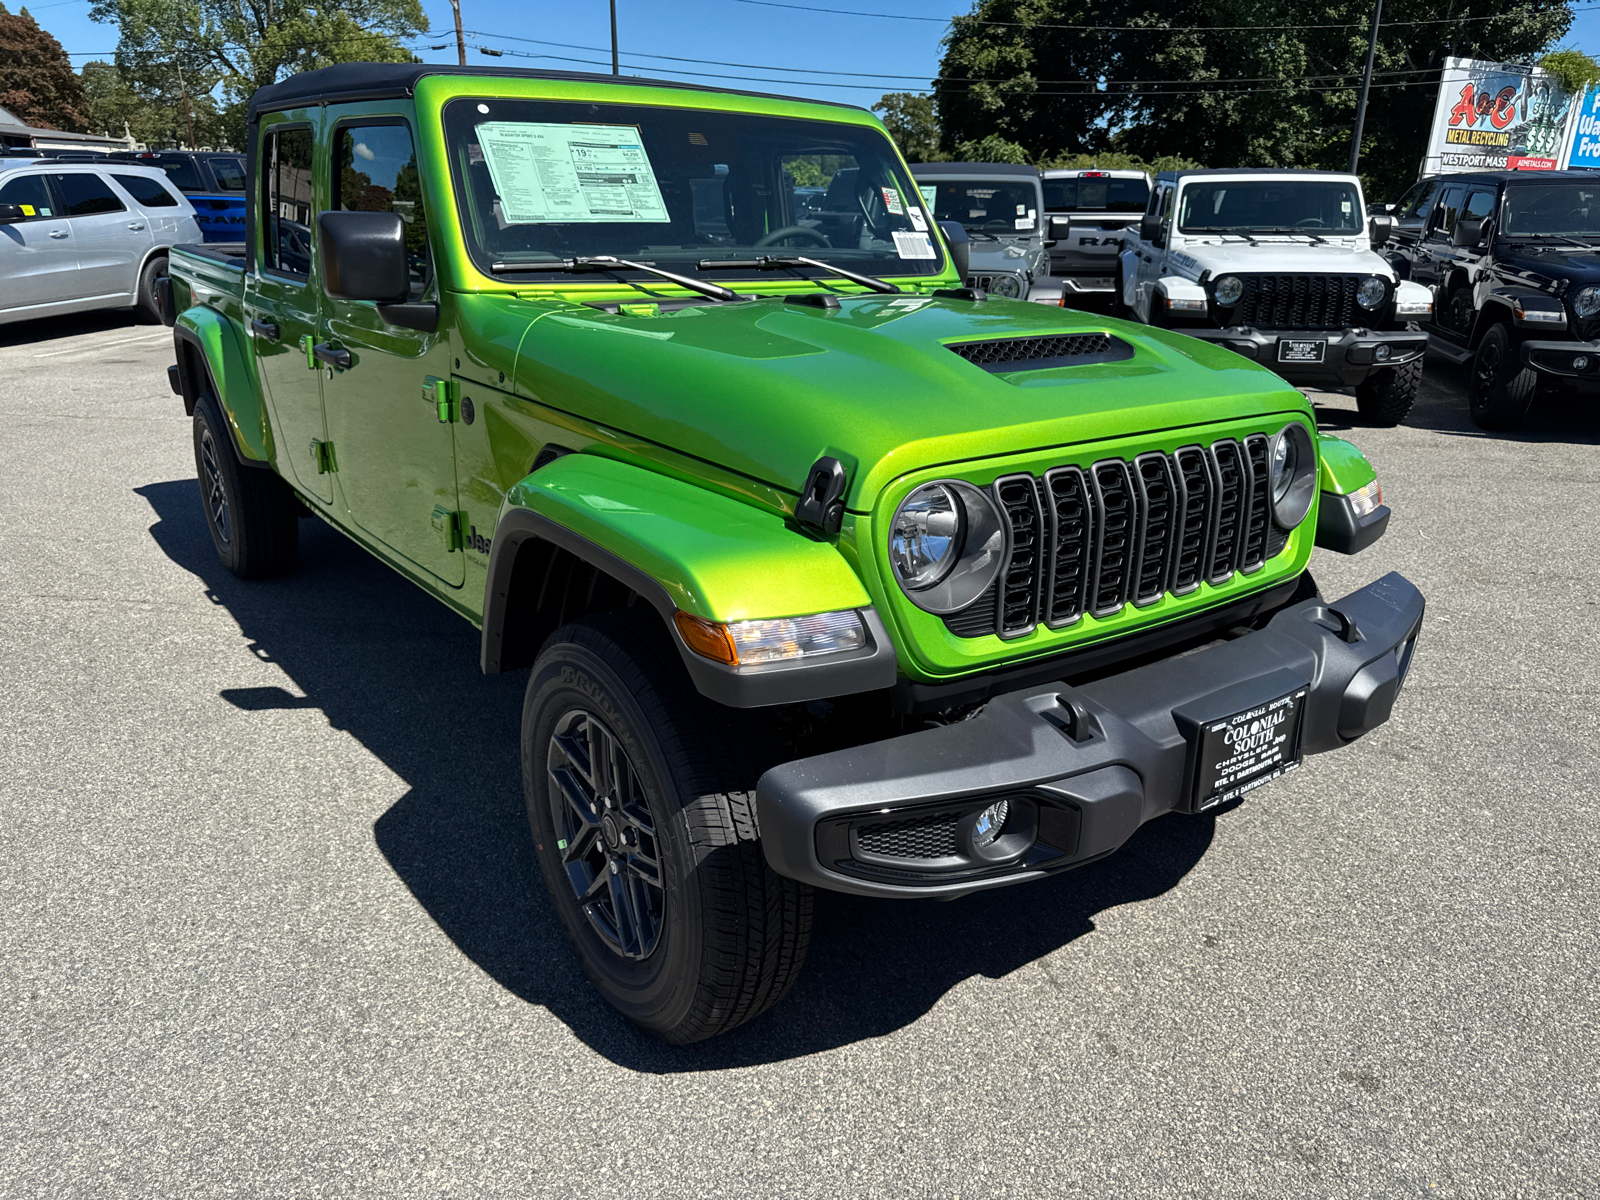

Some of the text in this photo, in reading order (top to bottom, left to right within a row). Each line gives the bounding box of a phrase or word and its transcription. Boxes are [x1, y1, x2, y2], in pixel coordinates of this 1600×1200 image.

[1579, 114, 1600, 138] Wa
[1447, 129, 1509, 147] METAL RECYCLING
[576, 149, 587, 157] 19
[1441, 153, 1508, 168] WESTPORT MASS
[199, 215, 246, 225] RAM
[1223, 709, 1286, 745] COLONIAL
[1232, 708, 1266, 725] COLONIAL
[1233, 726, 1275, 756] SOUTH
[1215, 734, 1286, 770] CHRYSLER Jeep
[1221, 746, 1280, 776] DODGE RAM
